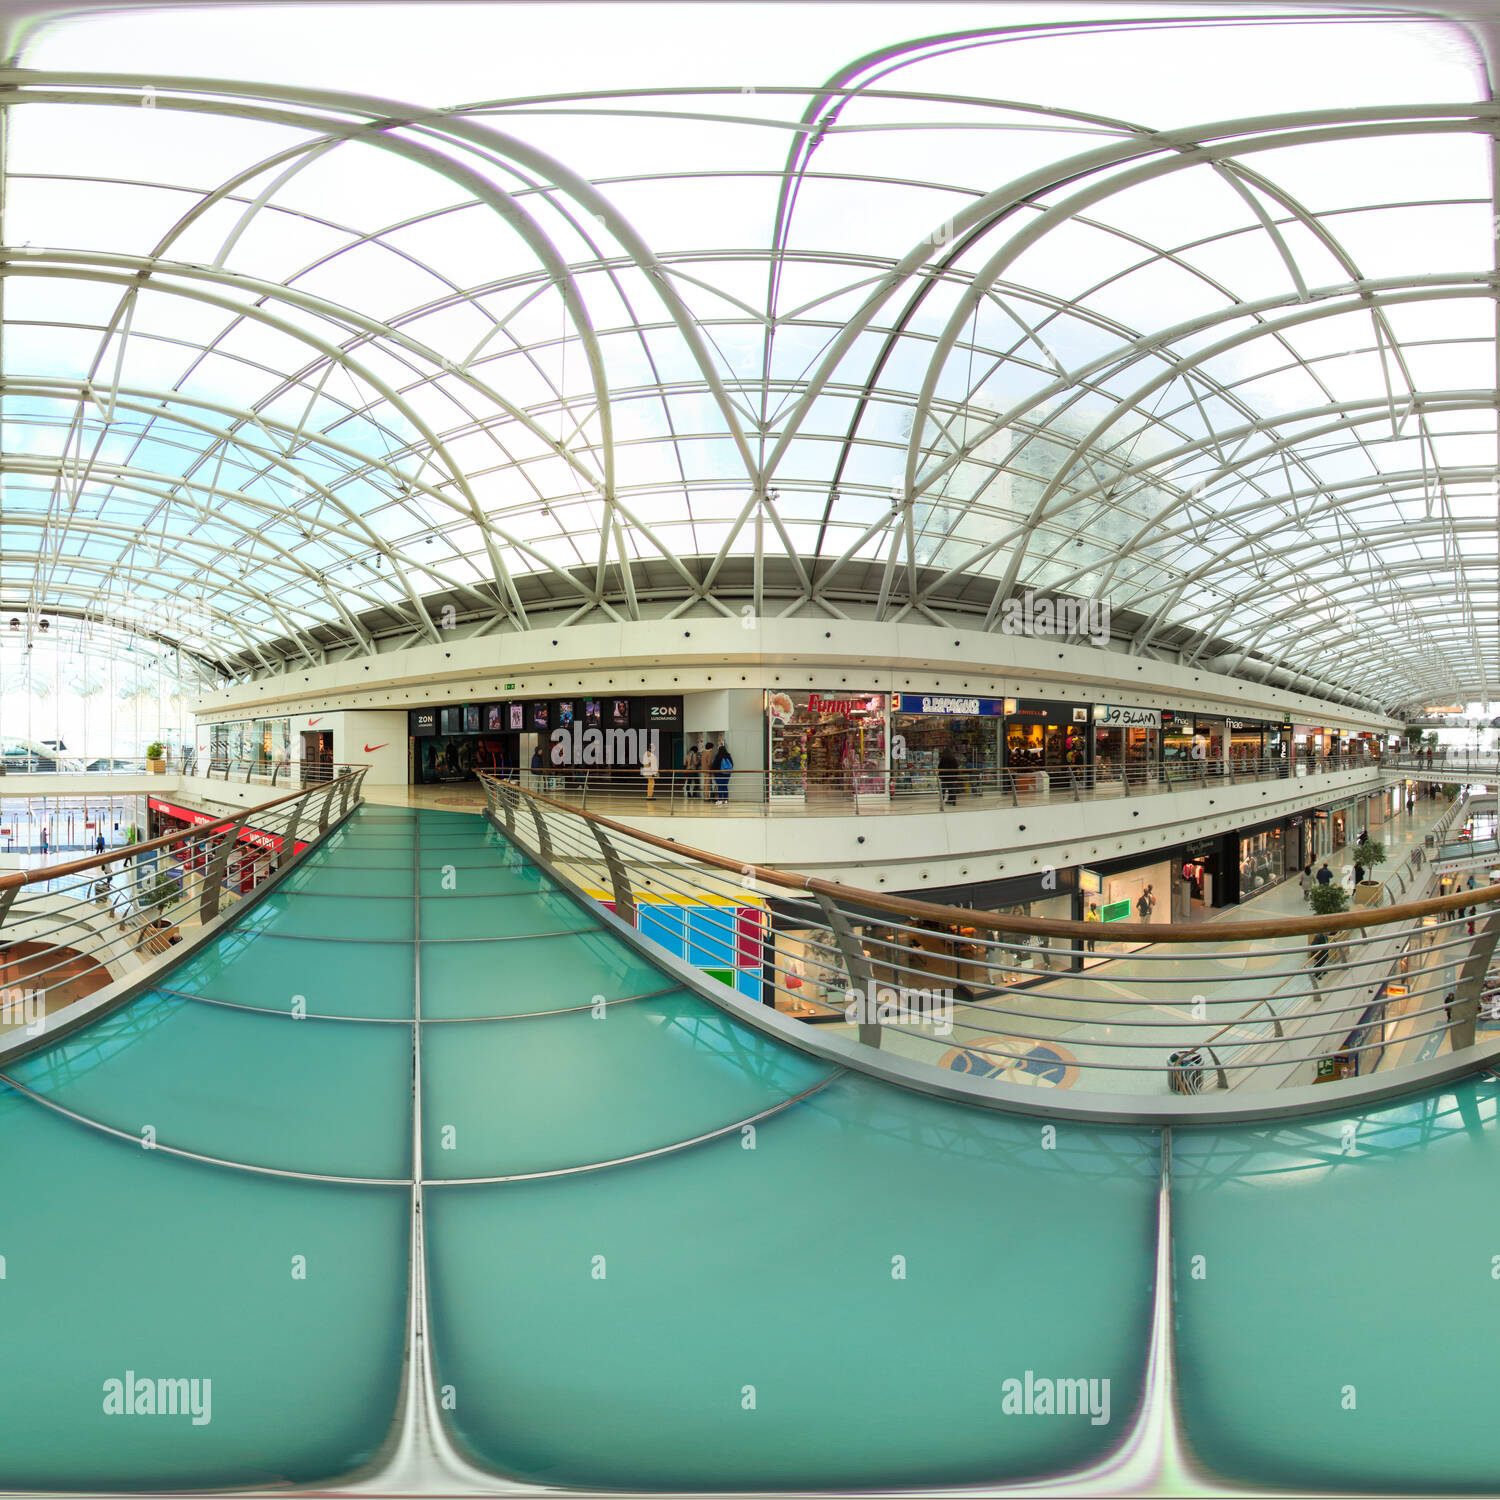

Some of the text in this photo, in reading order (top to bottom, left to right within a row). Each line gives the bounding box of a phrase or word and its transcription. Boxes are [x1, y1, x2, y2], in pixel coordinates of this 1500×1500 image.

[650, 706, 677, 716] ZON
[807, 693, 854, 717] Funny
[418, 715, 433, 724] ZON
[1123, 710, 1156, 726] SLAM
